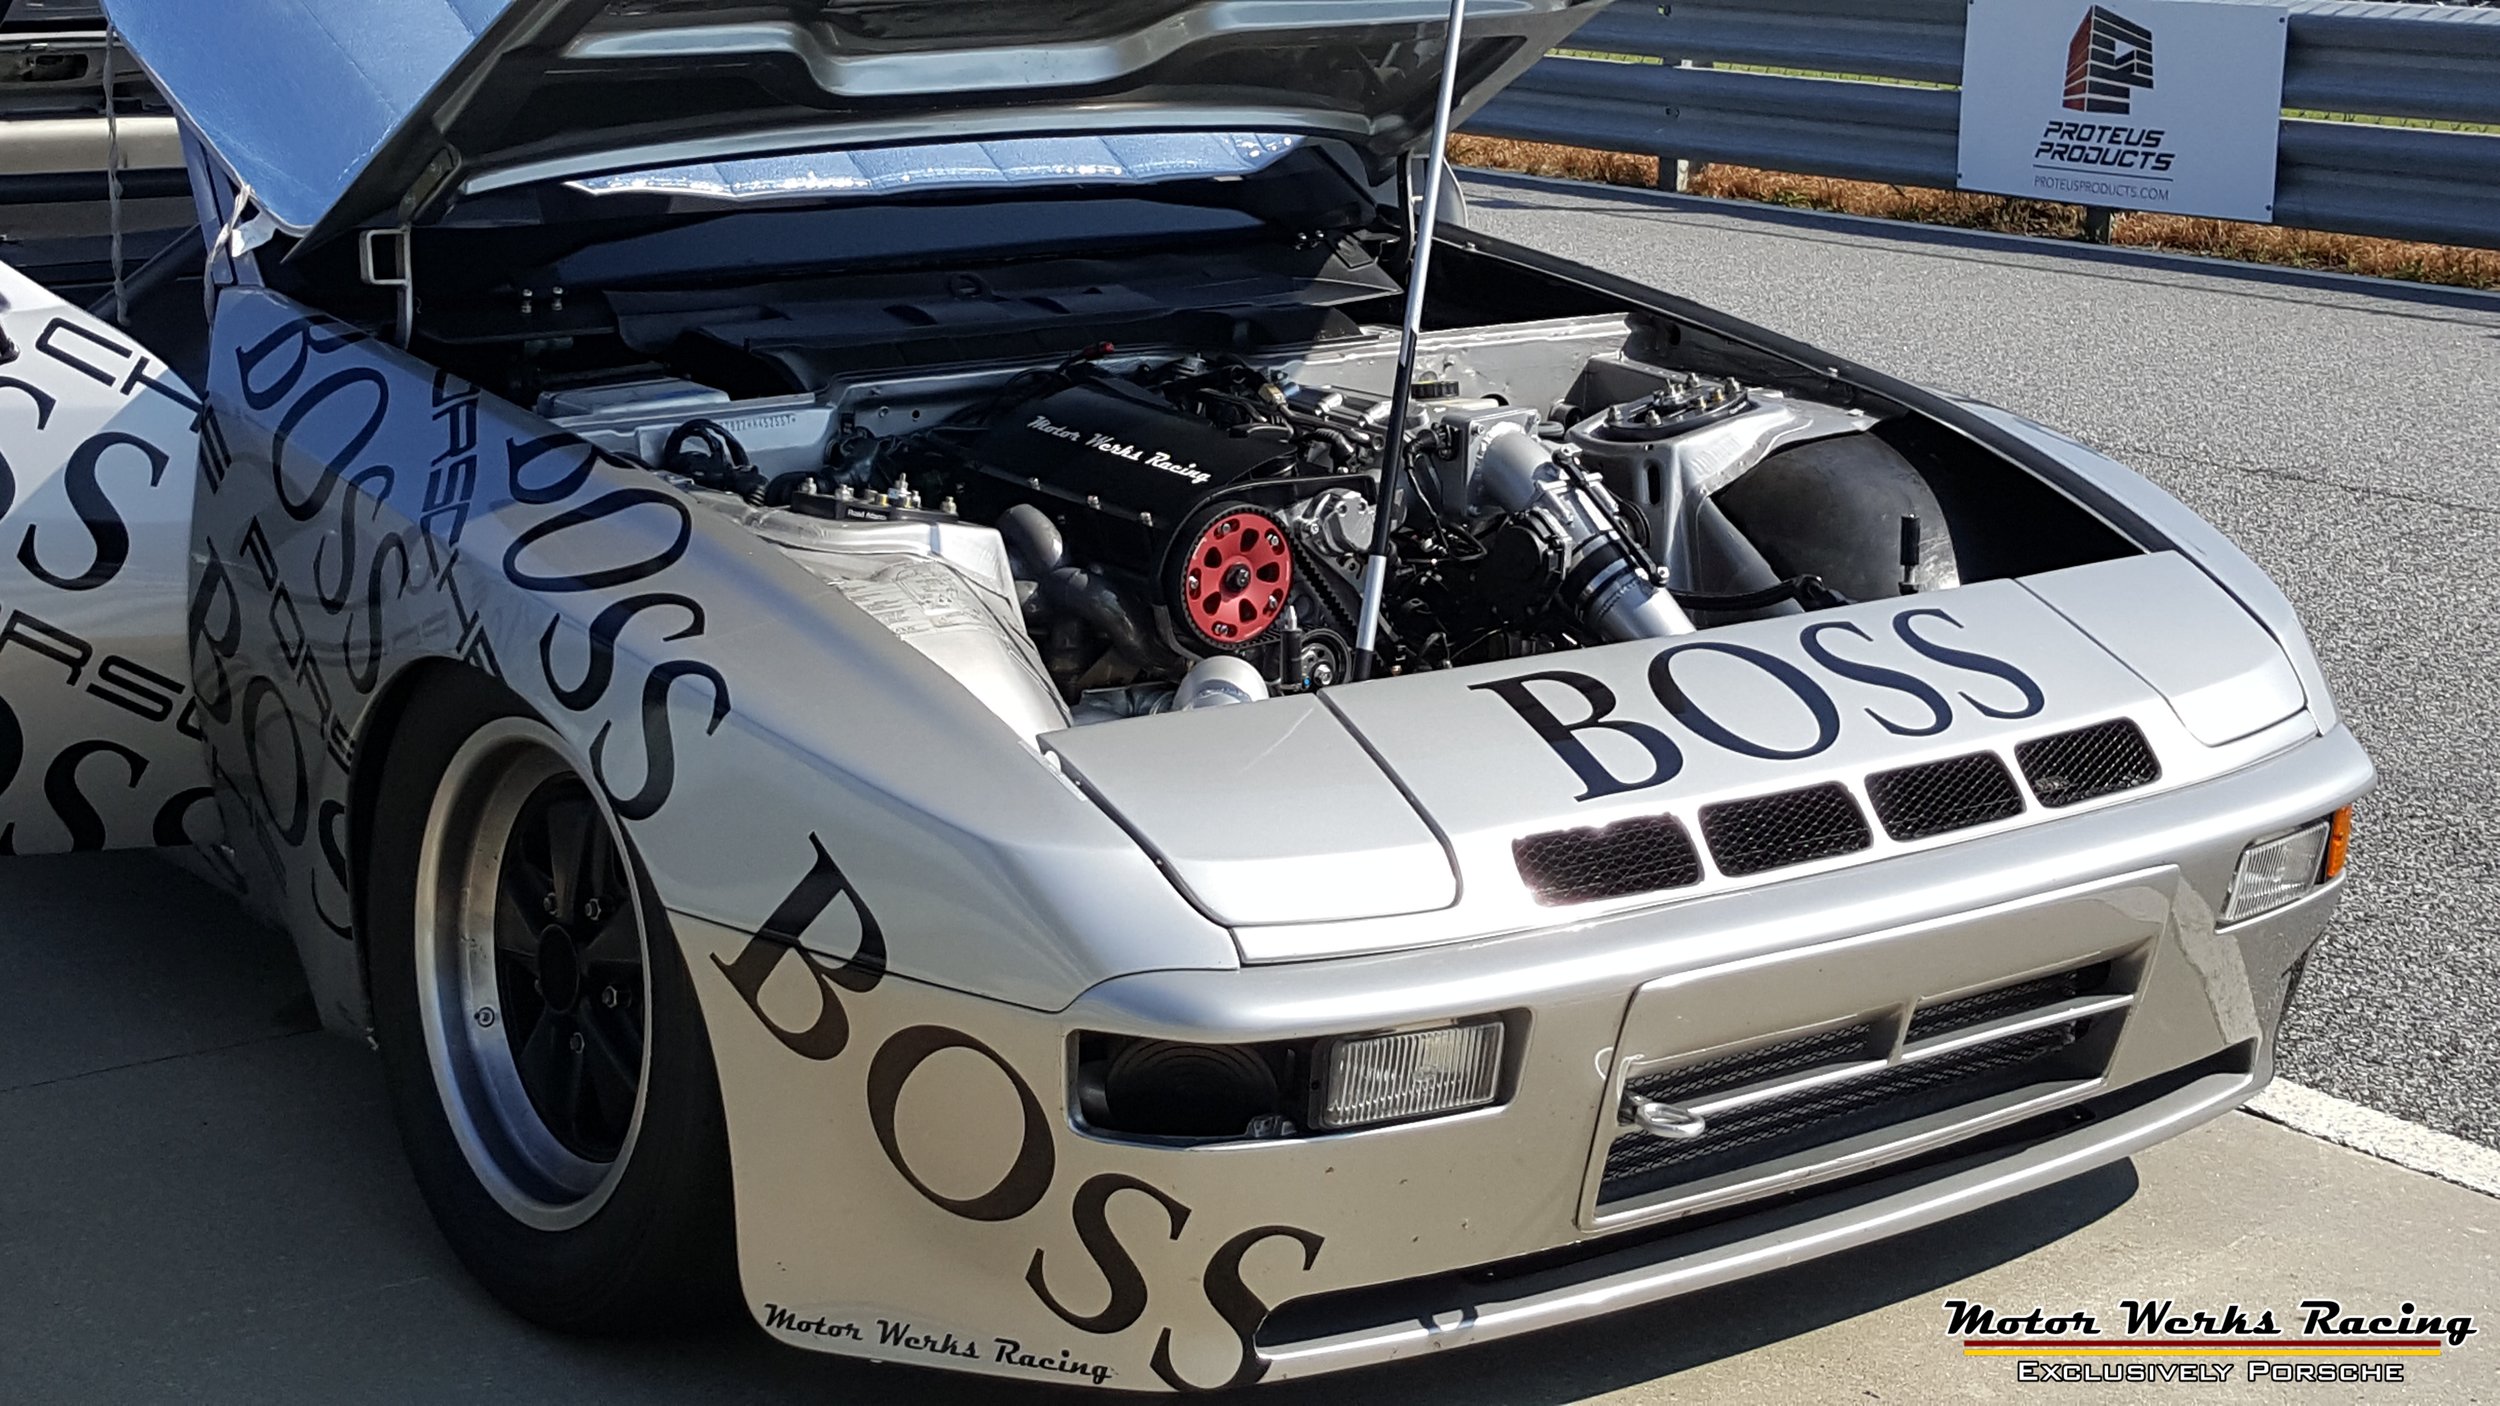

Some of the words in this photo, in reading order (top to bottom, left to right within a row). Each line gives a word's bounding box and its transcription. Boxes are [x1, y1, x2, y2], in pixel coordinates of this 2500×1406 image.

[2034, 141, 2176, 171] PRODUCTS
[2043, 120, 2165, 148] PROTEUS
[2034, 175, 2169, 201] PROTEUSPRODUCTS.COM
[1026, 415, 1081, 442] Motor
[1085, 432, 1144, 461] Werks
[1145, 451, 1211, 484] Racing
[235, 314, 410, 694] BOSS
[502, 432, 731, 820] BOSS
[1467, 608, 2046, 802] BOSS
[710, 831, 1326, 1391] BOSS
[764, 1303, 863, 1341] Motor
[876, 1319, 980, 1359] Werks
[994, 1337, 1114, 1384] Racing
